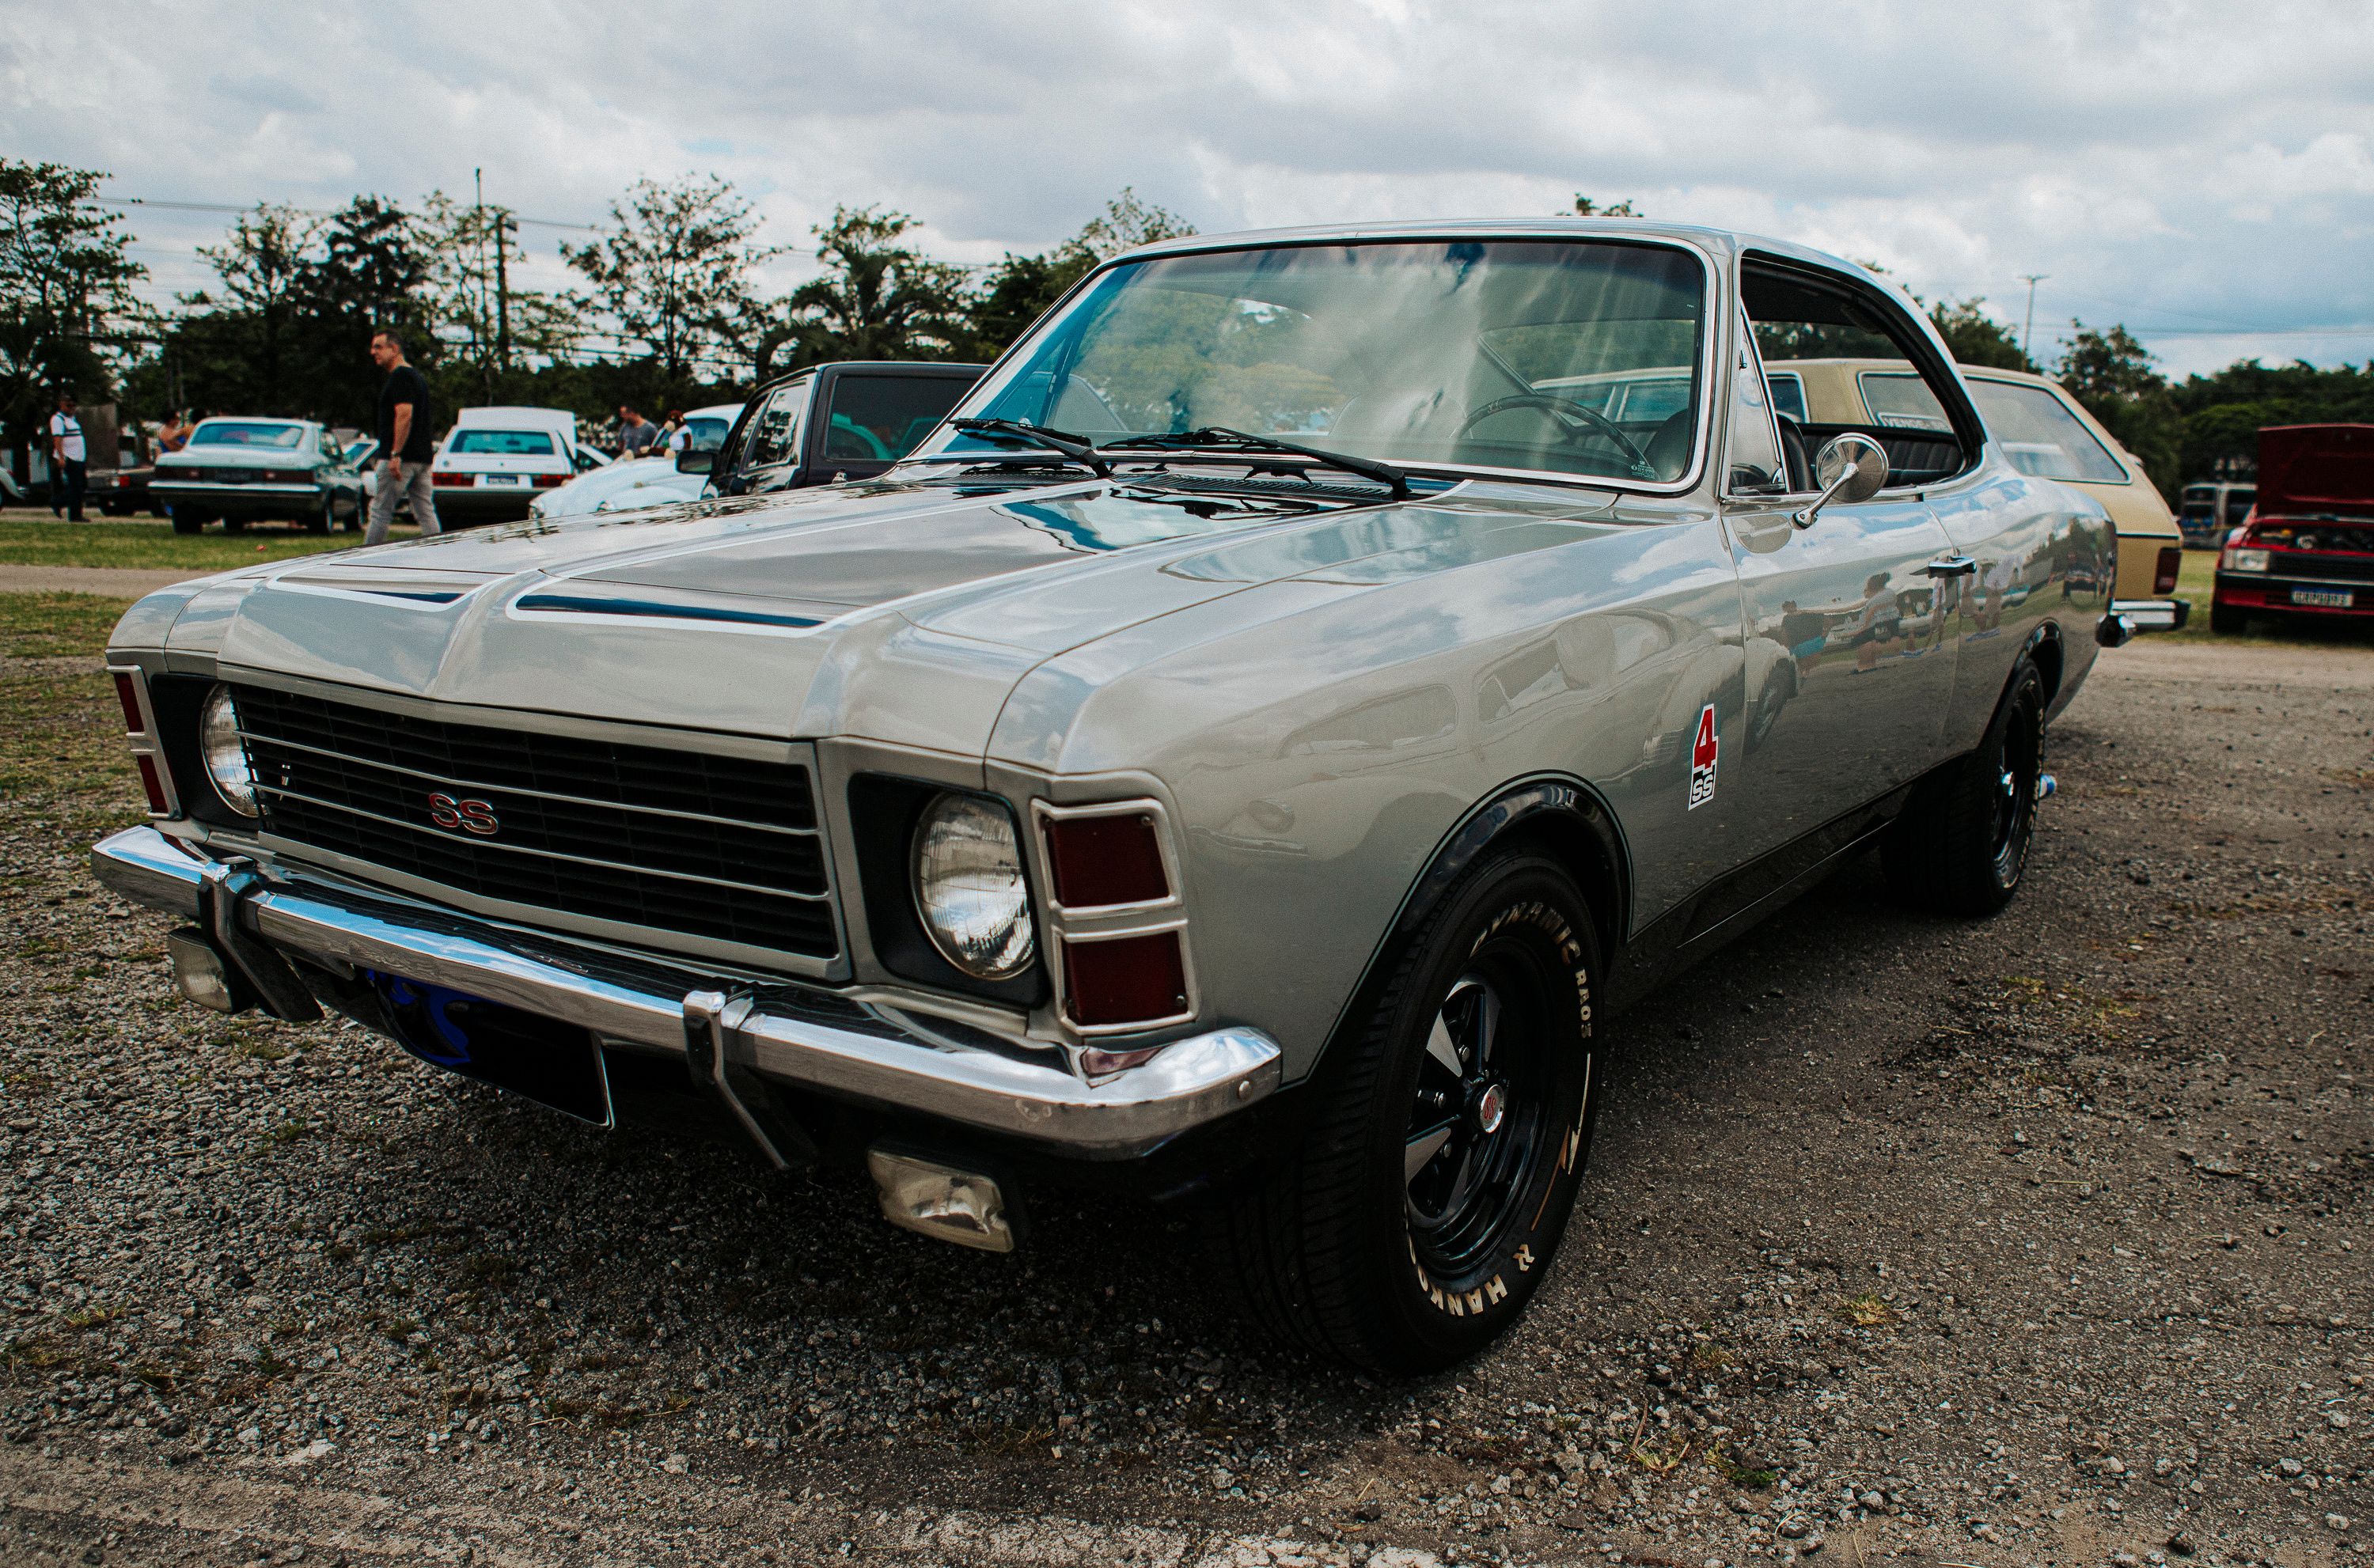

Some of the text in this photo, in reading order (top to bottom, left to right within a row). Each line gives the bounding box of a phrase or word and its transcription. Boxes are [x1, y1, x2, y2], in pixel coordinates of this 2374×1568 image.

[1693, 704, 1718, 772] 4
[1691, 774, 1714, 802] SS
[428, 793, 499, 835] SS
[1484, 1096, 1496, 1119] SS
